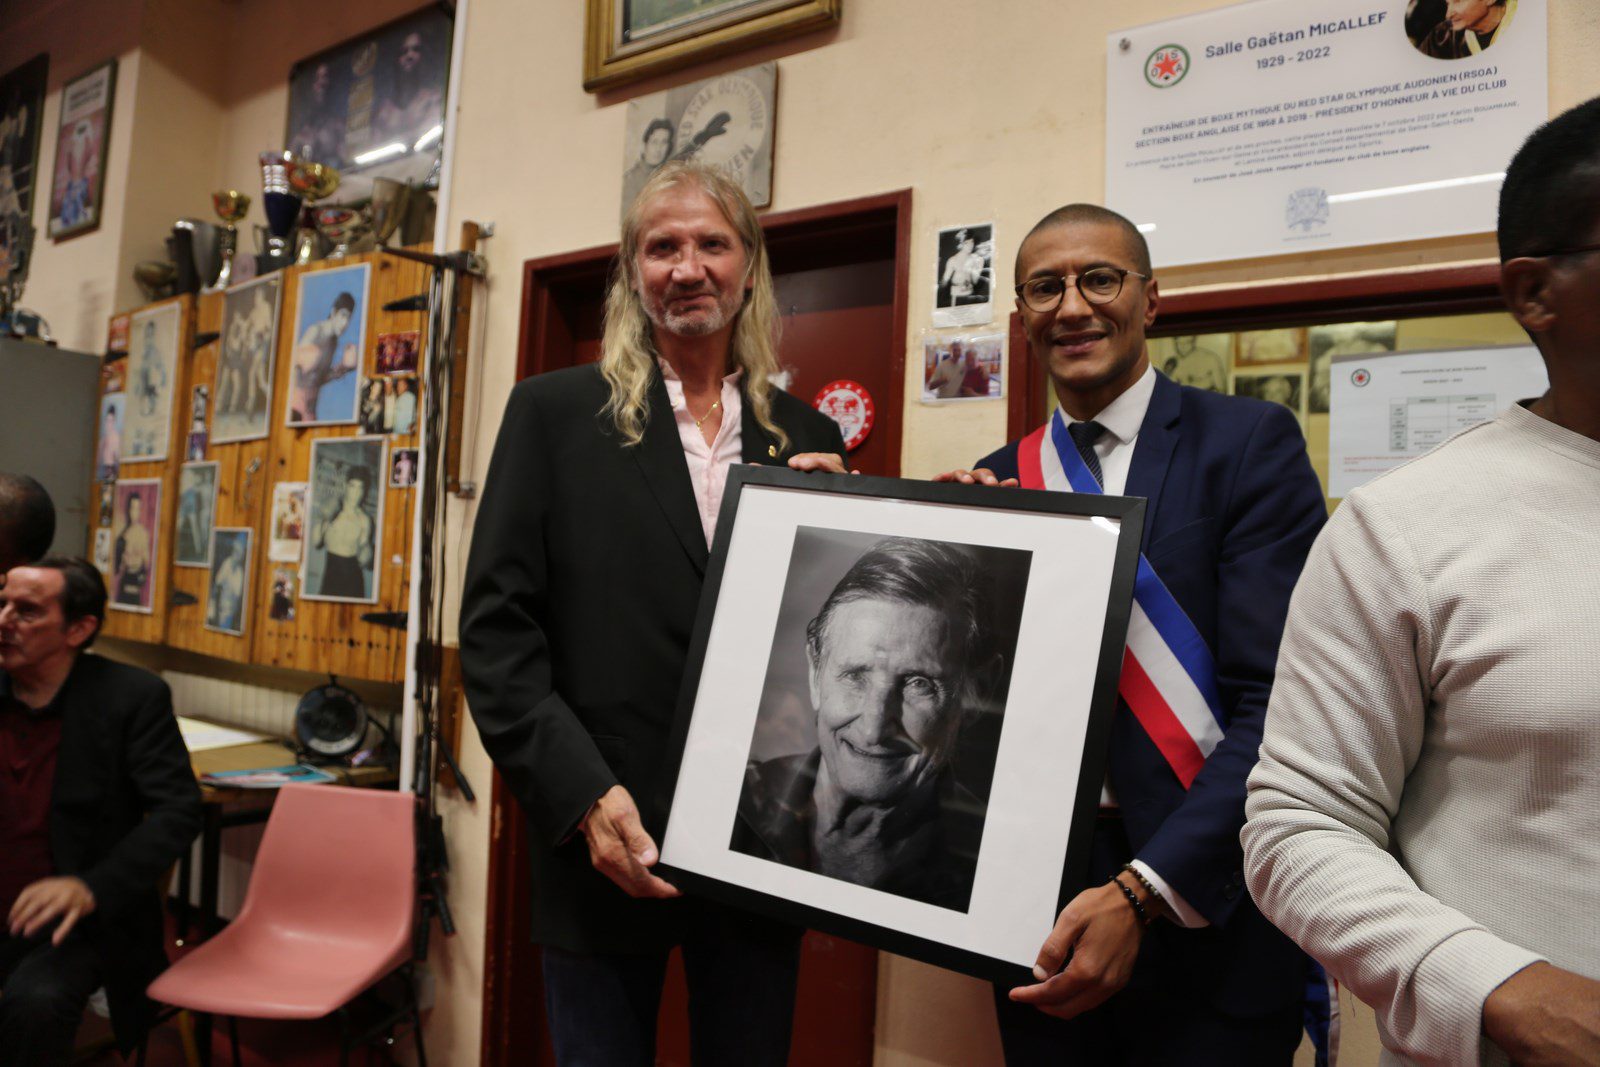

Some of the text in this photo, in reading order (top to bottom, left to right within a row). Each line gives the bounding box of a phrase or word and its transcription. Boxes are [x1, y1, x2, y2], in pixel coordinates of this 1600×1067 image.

[1205, 11, 1388, 58] Salle Gaëtan MICALLEF
[1256, 54, 1285, 69] 1929
[1297, 46, 1330, 62] 2022
[1135, 135, 1170, 148] SECTION
[1172, 131, 1193, 141] BOXE
[1197, 123, 1239, 137] ANGLAISE
[1242, 121, 1253, 130] DE
[1314, 101, 1367, 118] PRÉSIDENT
[1441, 87, 1457, 97] VIE
[1460, 84, 1474, 94] DU
[1477, 78, 1506, 91] CLUB
[1198, 116, 1207, 125] DE
[1210, 112, 1232, 122] BOXE
[1236, 104, 1280, 118] MYTHIQUE
[1283, 101, 1296, 110] DU
[1298, 97, 1316, 107] RED
[1318, 93, 1343, 104] STAR
[1345, 83, 1400, 99] OLYMPIQUE
[1404, 73, 1456, 90] AUDONIEN
[1458, 66, 1497, 80] (RSOA)
